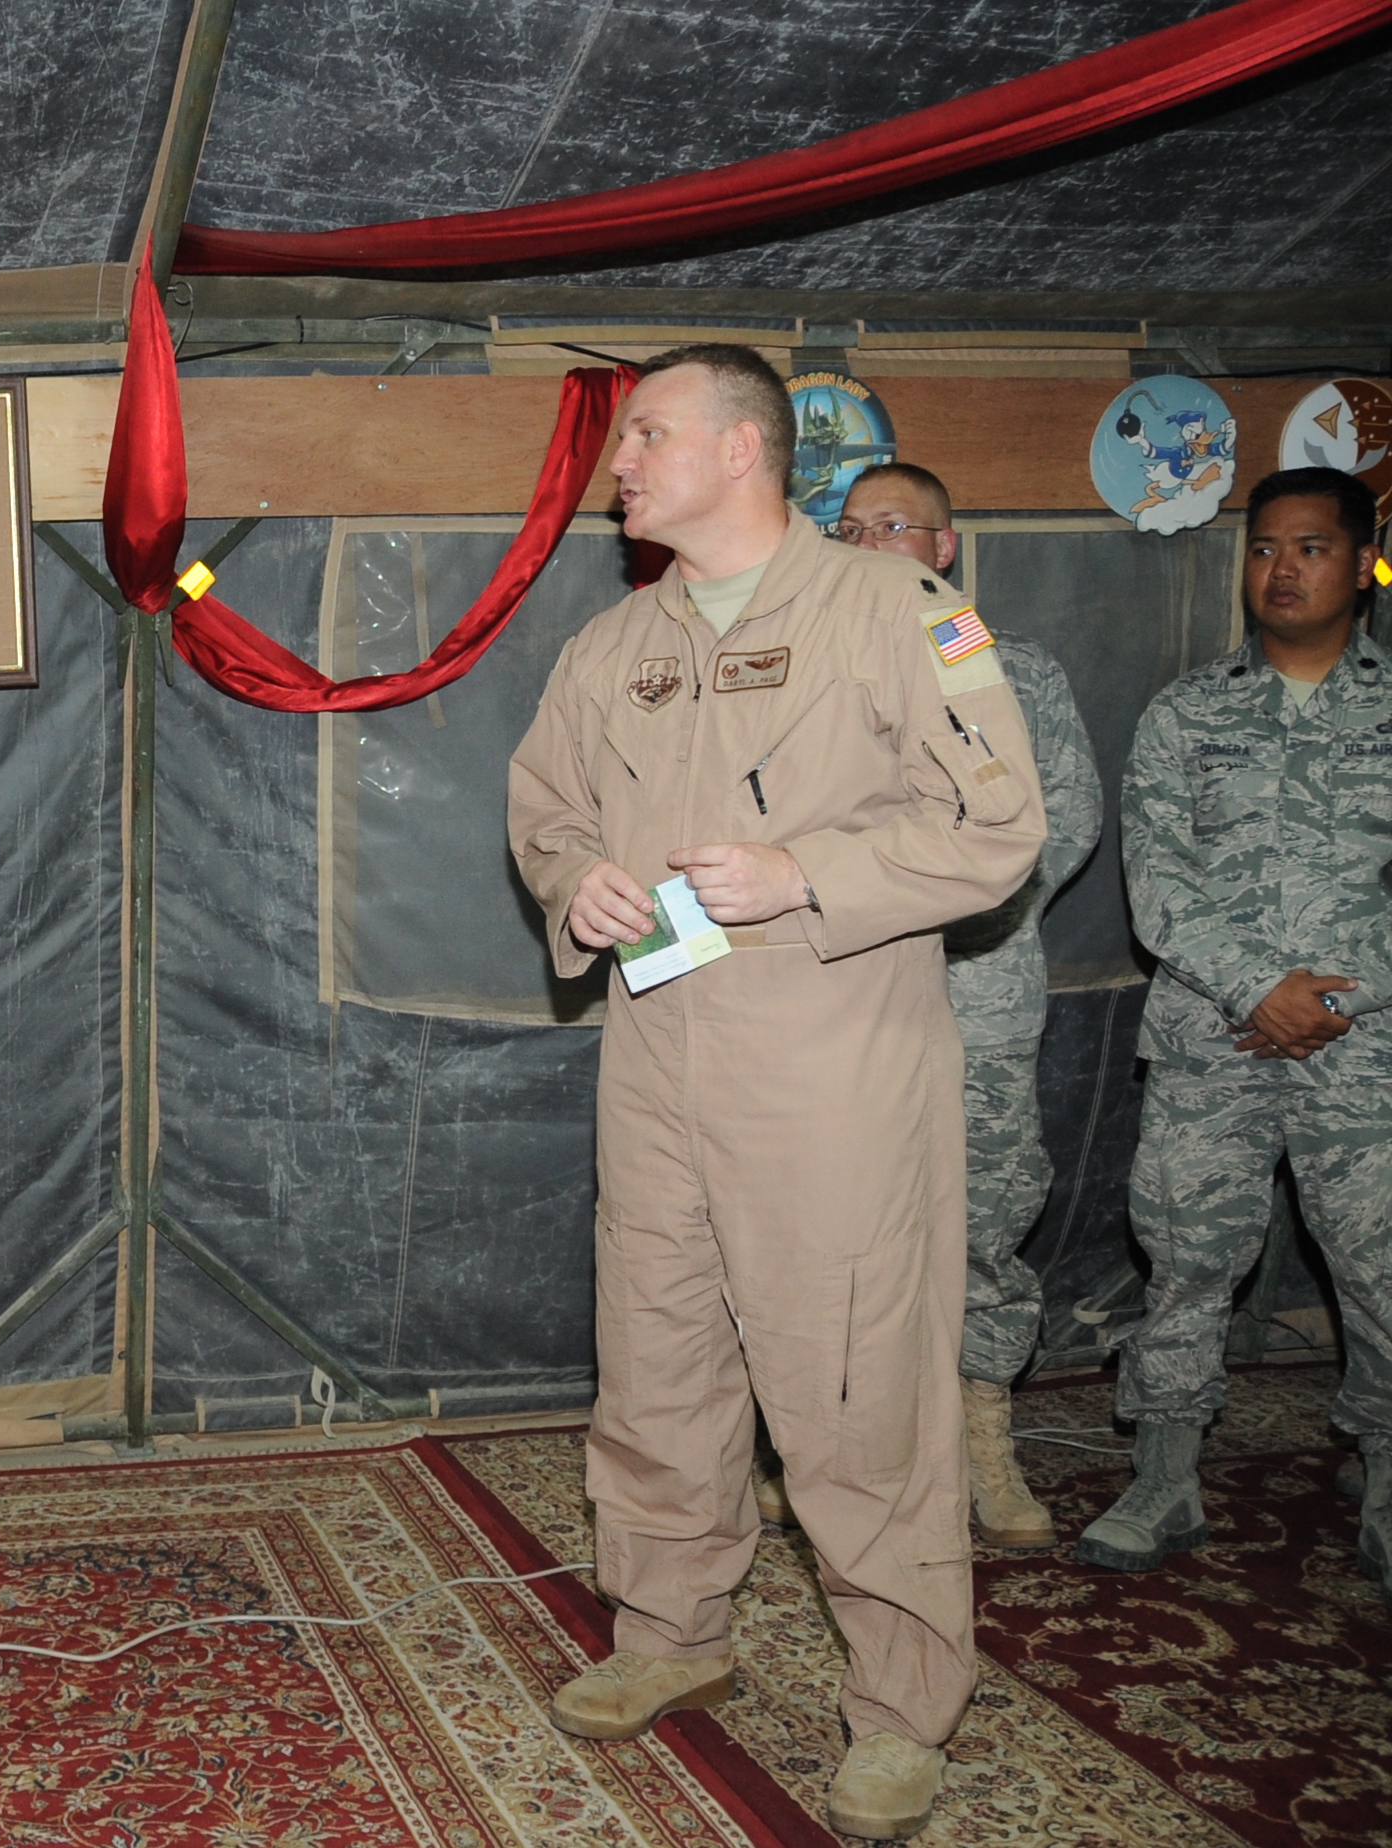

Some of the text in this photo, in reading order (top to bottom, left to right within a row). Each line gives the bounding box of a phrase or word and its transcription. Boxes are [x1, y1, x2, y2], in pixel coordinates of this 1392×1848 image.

[836, 375, 871, 402] LADY
[1200, 743, 1250, 756] SUMERA
[1369, 743, 1392, 756] AIR
